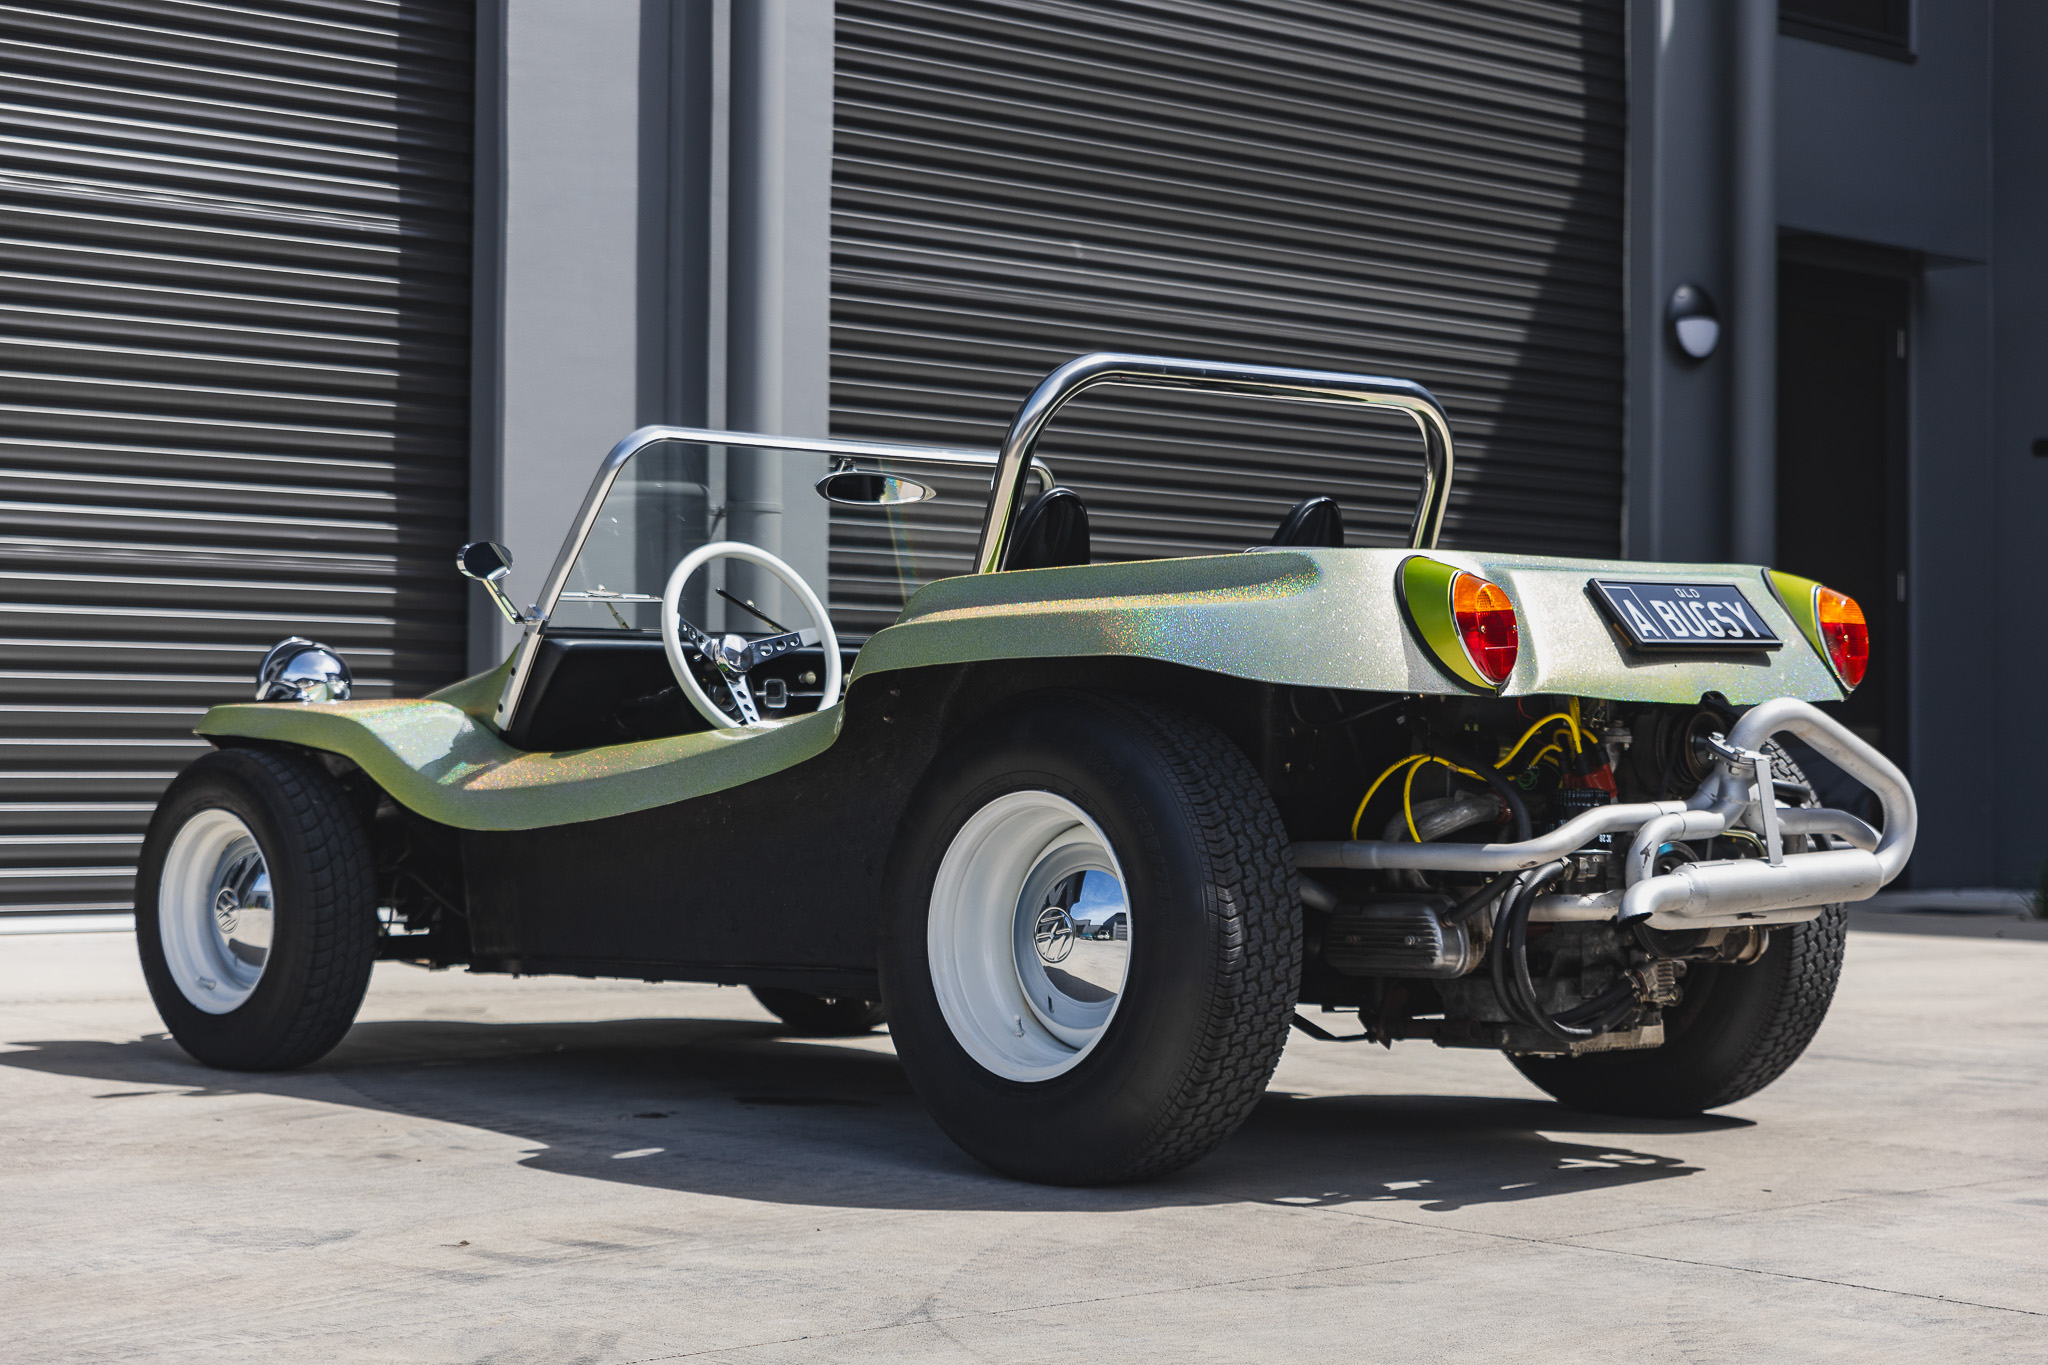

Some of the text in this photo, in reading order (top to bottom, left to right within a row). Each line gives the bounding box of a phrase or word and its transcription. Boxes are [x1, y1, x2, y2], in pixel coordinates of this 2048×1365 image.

[1674, 588, 1700, 598] QLD
[1623, 599, 1761, 638] A BUGSY
